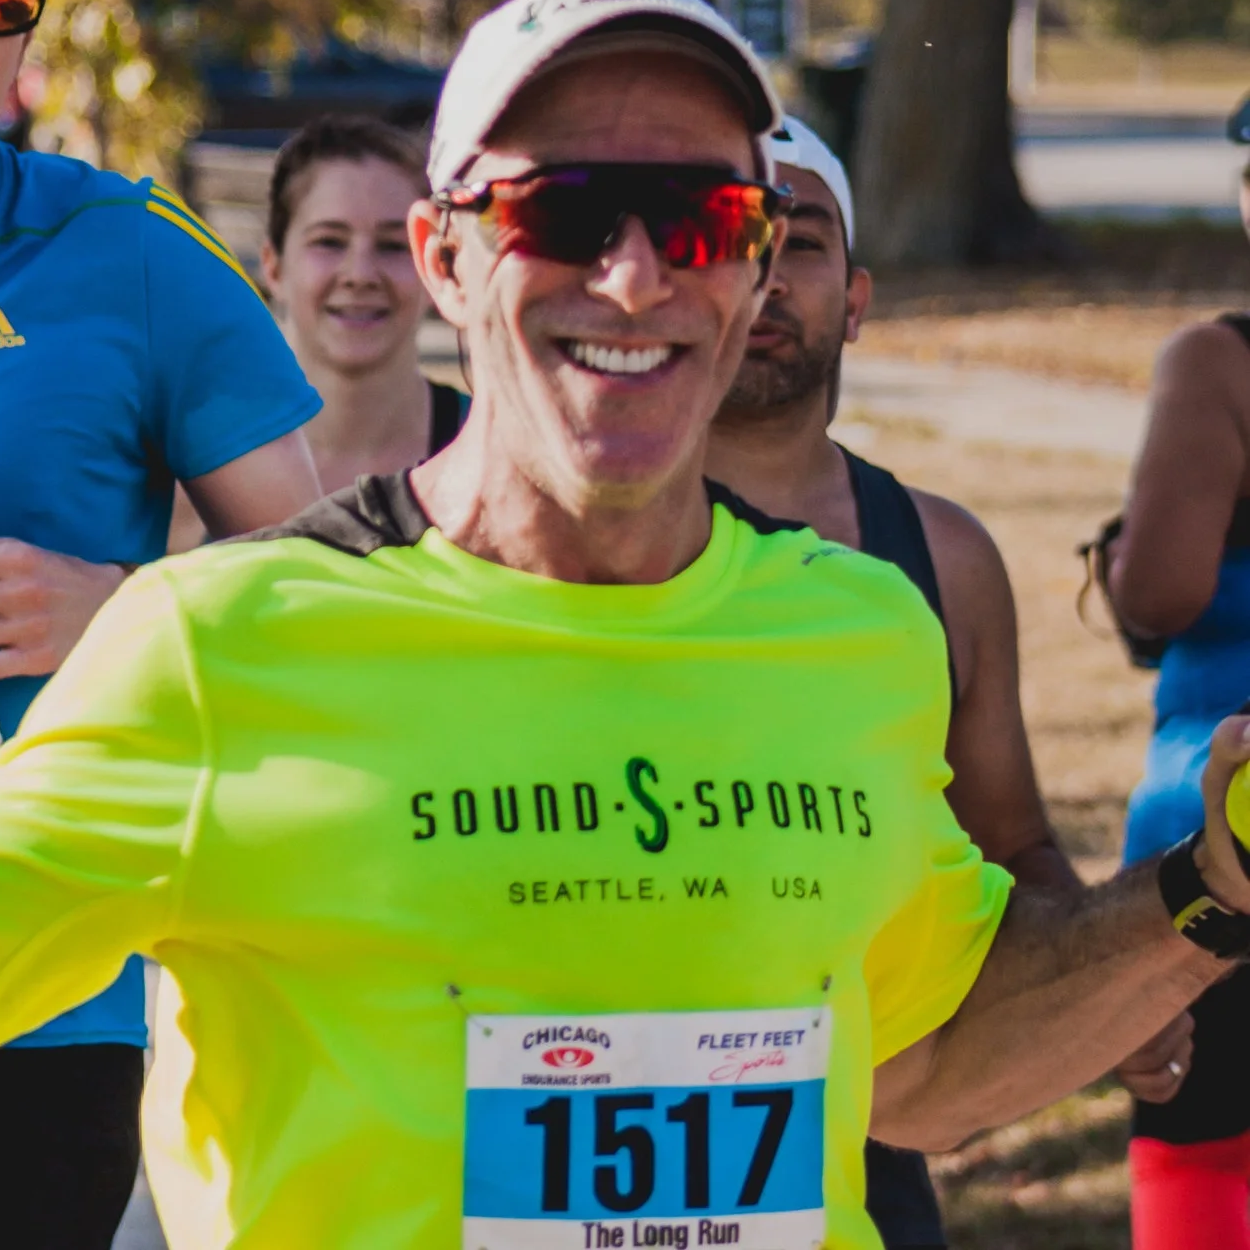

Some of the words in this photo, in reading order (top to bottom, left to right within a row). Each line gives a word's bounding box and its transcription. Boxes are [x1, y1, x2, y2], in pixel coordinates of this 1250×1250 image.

[411, 782, 599, 840] SOUND
[694, 780, 872, 838] SPORTS
[508, 878, 665, 904] SEATTLE,
[683, 877, 729, 899] WA
[771, 877, 823, 900] USA
[522, 1025, 612, 1049] CHICAGO
[697, 1032, 759, 1050] FLEET
[762, 1029, 806, 1047] FEET
[524, 1088, 795, 1213] 1517
[582, 1221, 624, 1249] The
[632, 1221, 689, 1250] Long
[697, 1218, 740, 1246] Run
